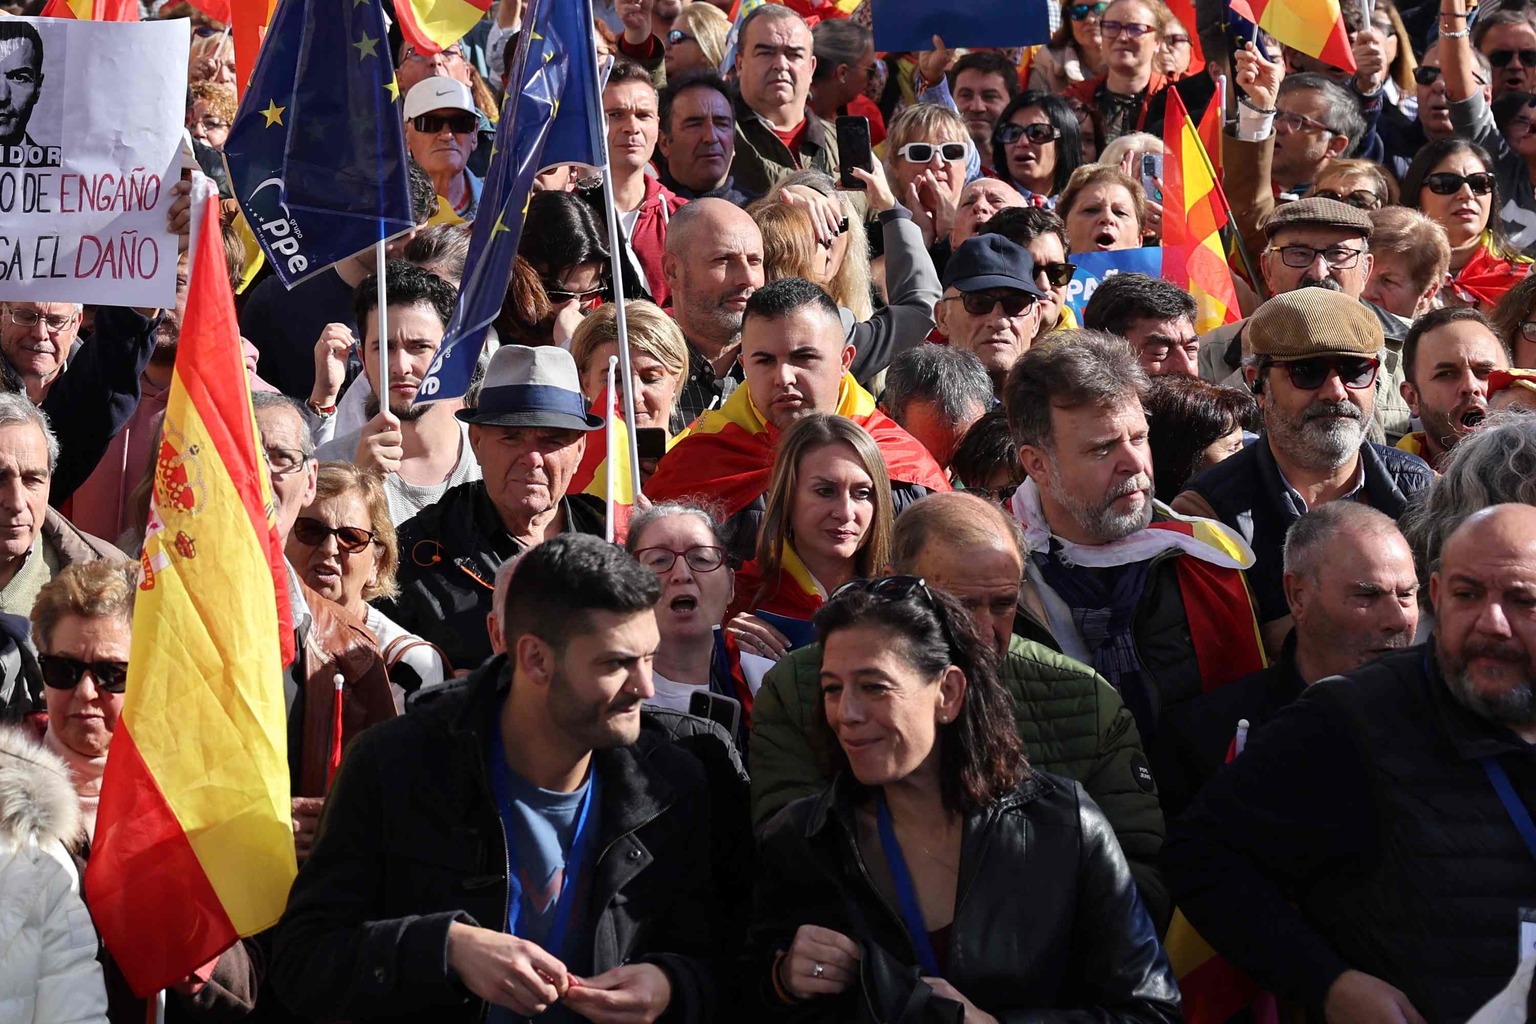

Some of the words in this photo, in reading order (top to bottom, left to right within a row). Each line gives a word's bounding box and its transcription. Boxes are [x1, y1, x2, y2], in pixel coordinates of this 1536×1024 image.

[22, 174, 52, 214] DE
[60, 167, 160, 214] ENGAÑO
[262, 218, 308, 274] ppe
[289, 218, 303, 239] grupo
[32, 236, 67, 278] EL
[74, 231, 159, 280] DAÑO
